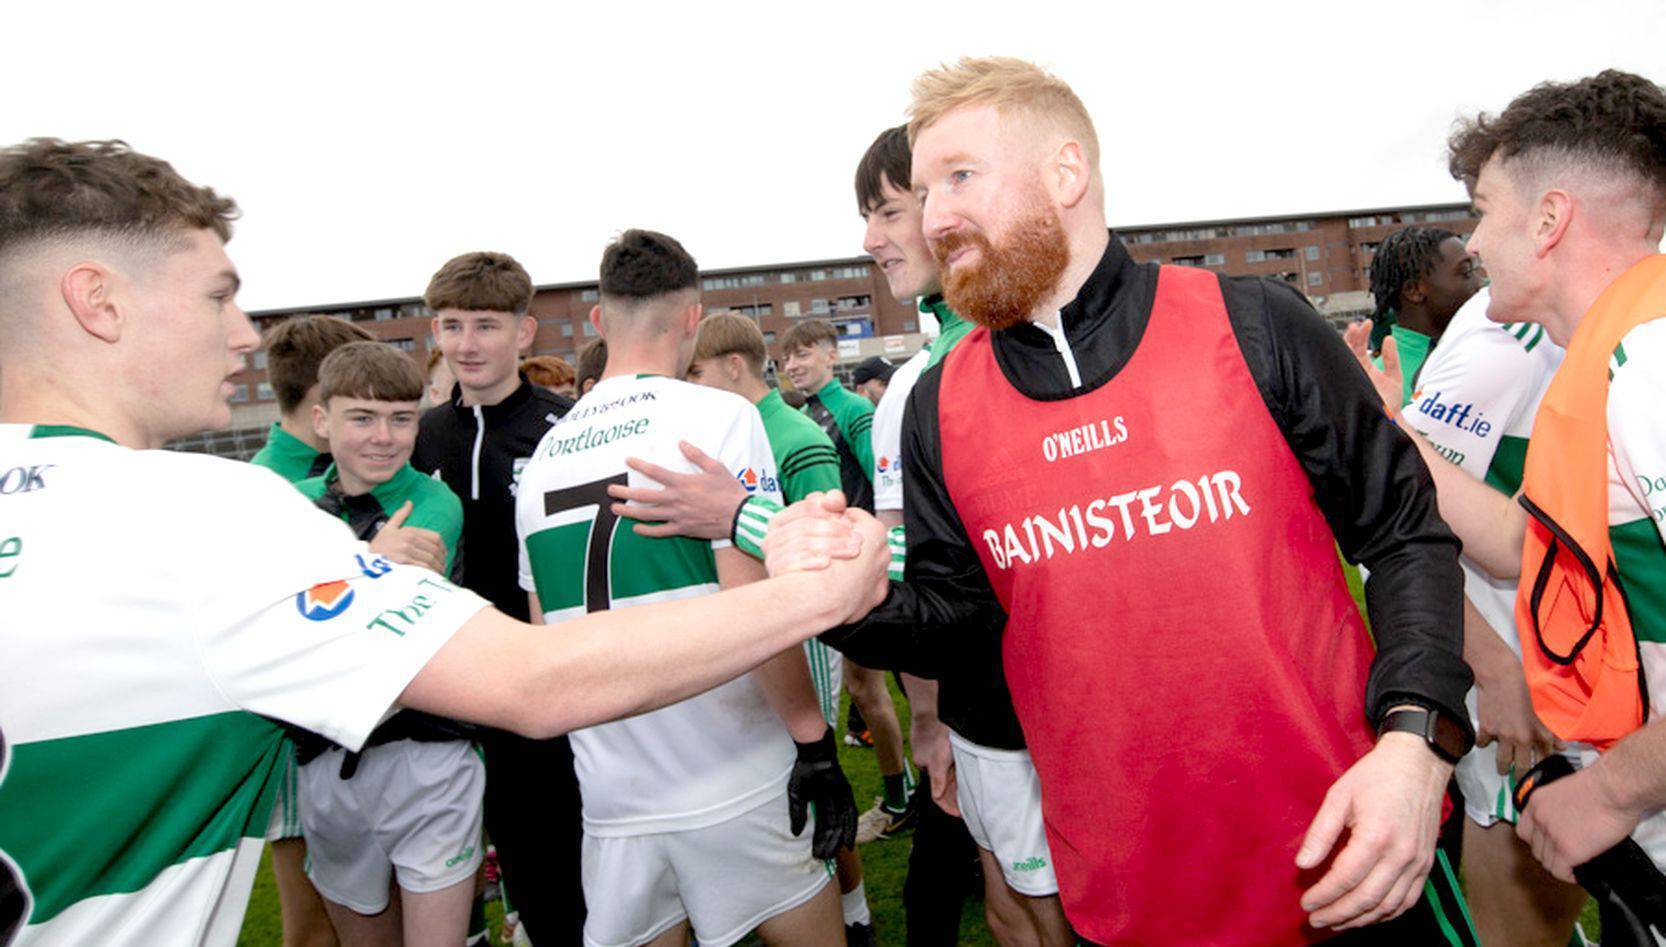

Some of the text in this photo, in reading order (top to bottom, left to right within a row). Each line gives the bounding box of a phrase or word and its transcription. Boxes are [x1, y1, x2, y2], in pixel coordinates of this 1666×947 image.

[1042, 415, 1128, 462] O'NEILLS
[1418, 391, 1492, 438] daft.ie
[543, 471, 632, 614] 7
[982, 470, 1251, 570] BAINISTEOIR
